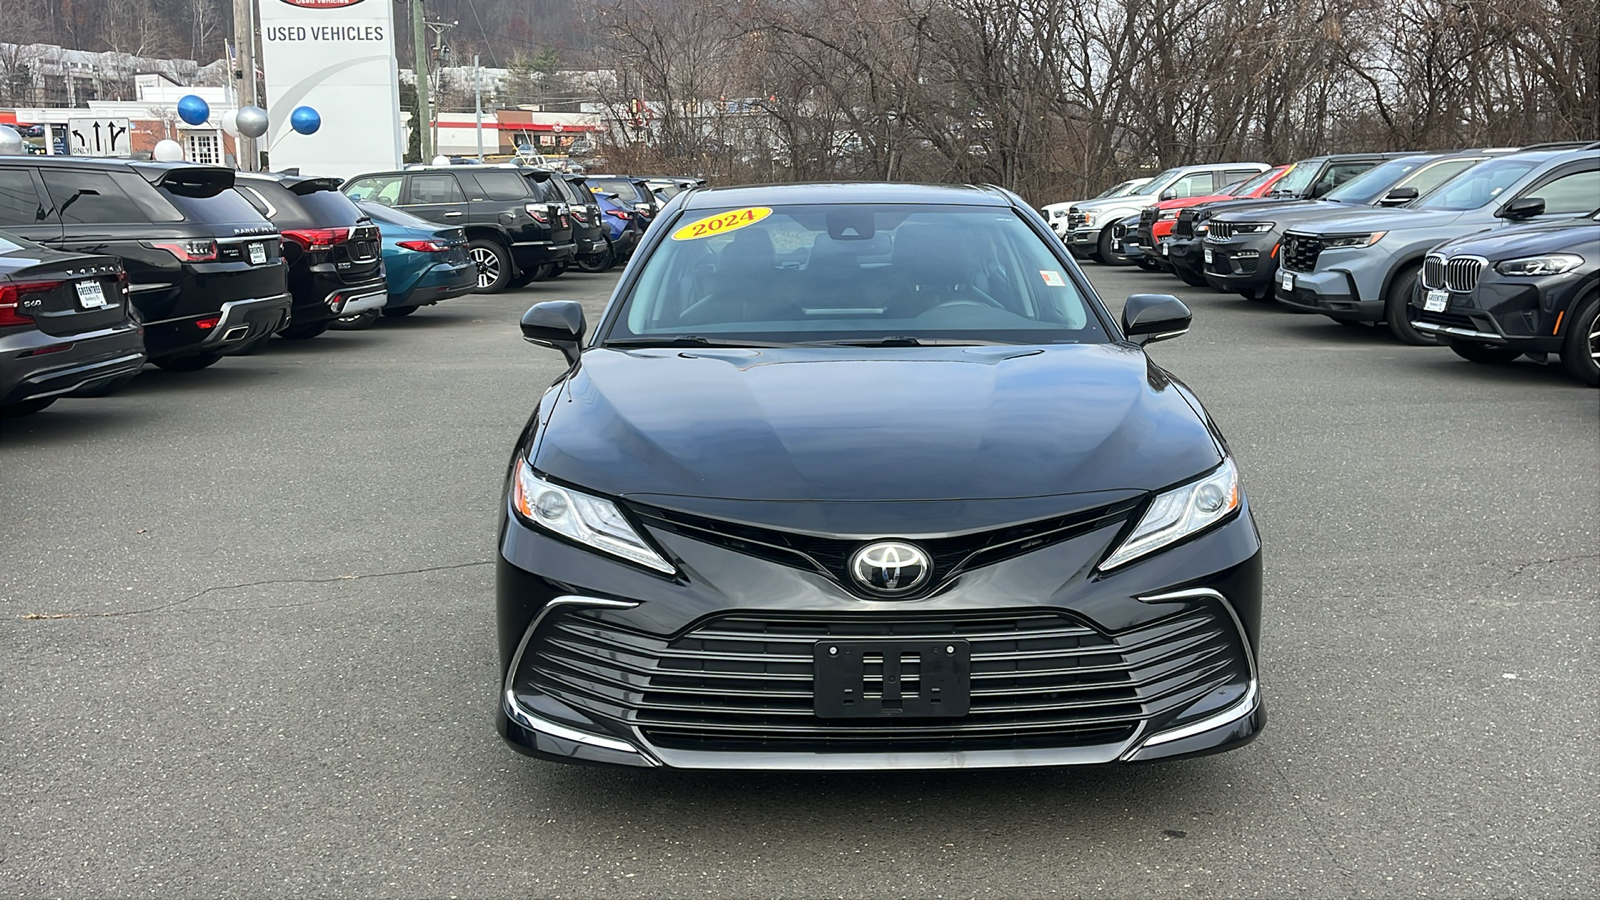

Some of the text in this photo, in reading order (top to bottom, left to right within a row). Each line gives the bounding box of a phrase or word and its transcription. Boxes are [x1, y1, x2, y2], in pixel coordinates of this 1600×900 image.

[267, 26, 383, 41] USED VEHICLES
[72, 146, 91, 155] ONLY
[692, 209, 757, 237] 2024
[77, 284, 102, 296] GREENTREE
[24, 299, 42, 308] S60
